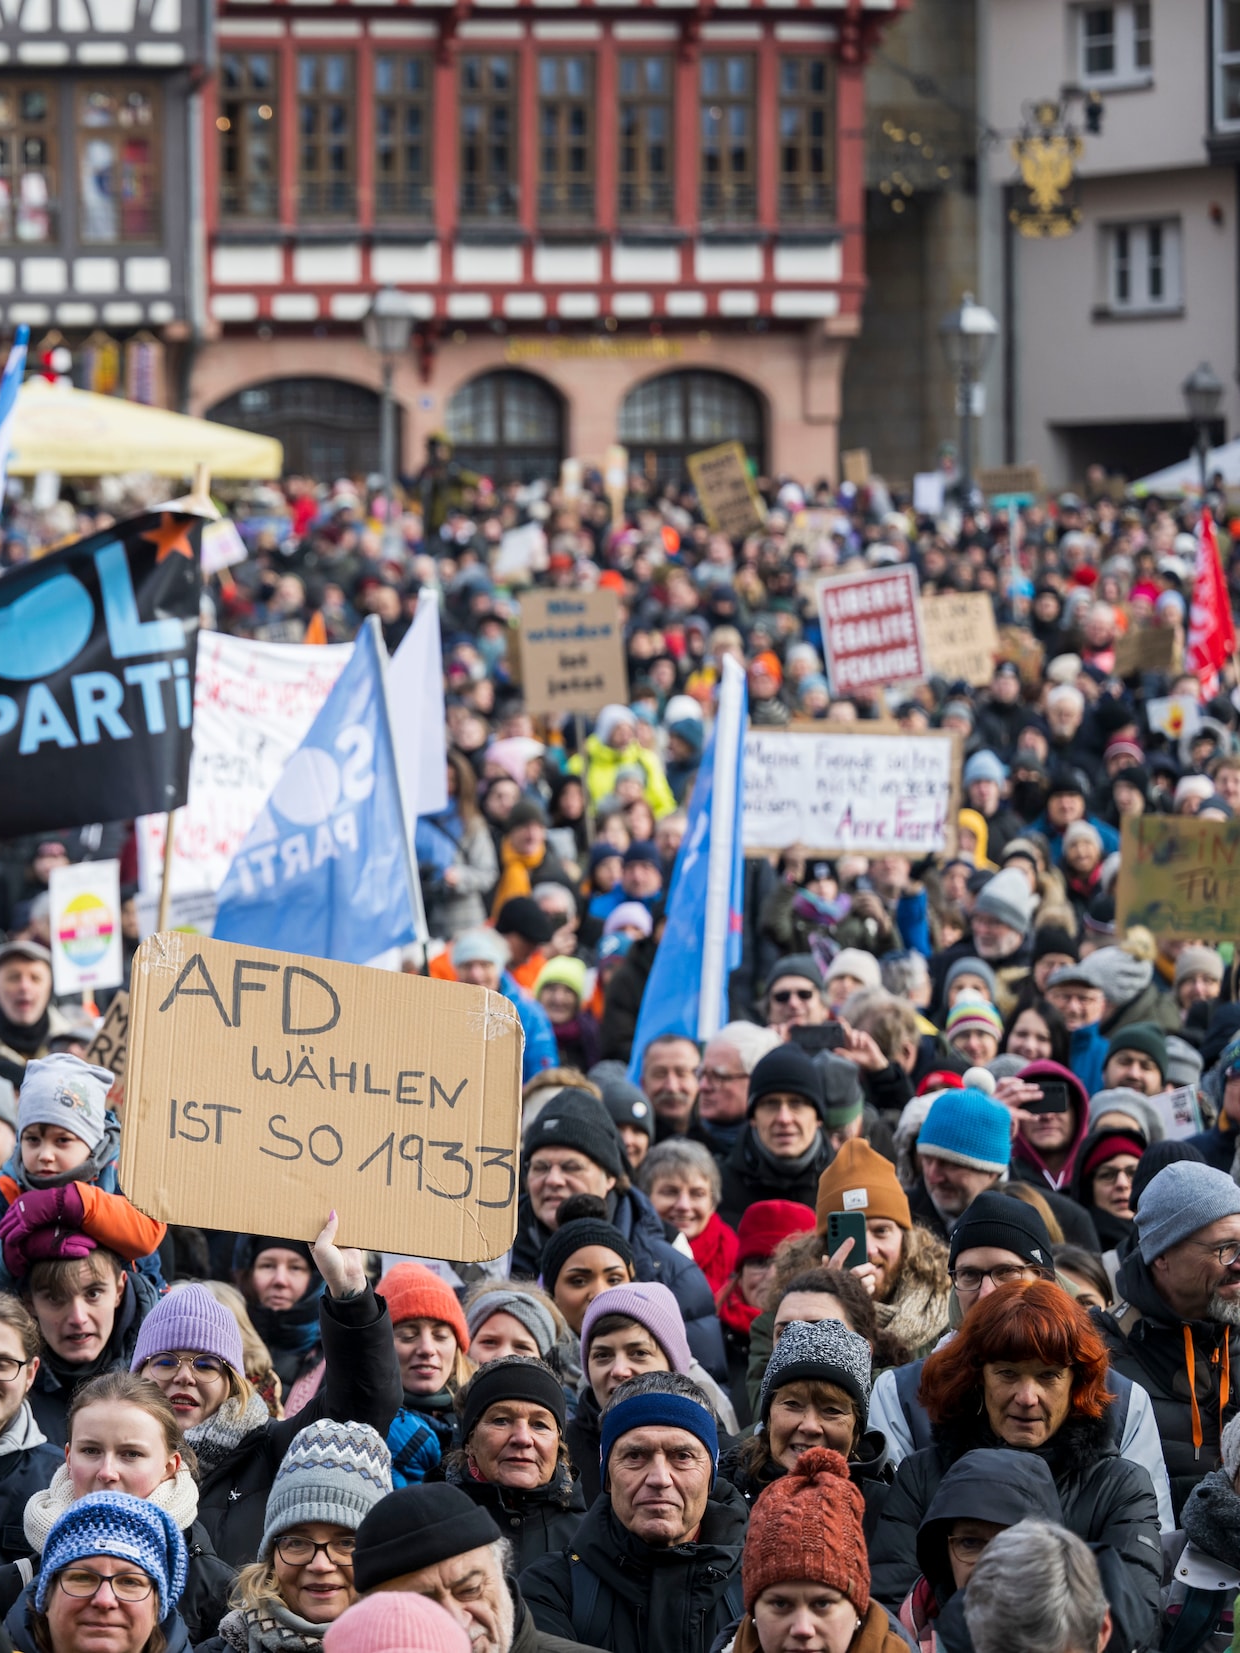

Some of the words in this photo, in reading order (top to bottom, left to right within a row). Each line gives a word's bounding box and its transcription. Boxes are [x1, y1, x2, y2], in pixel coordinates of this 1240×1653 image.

[159, 953, 342, 1036] AFD
[251, 1044, 469, 1109] WÄHLEN
[169, 1099, 242, 1145] IST
[259, 1114, 344, 1167] SO
[357, 1131, 517, 1209] 1933
